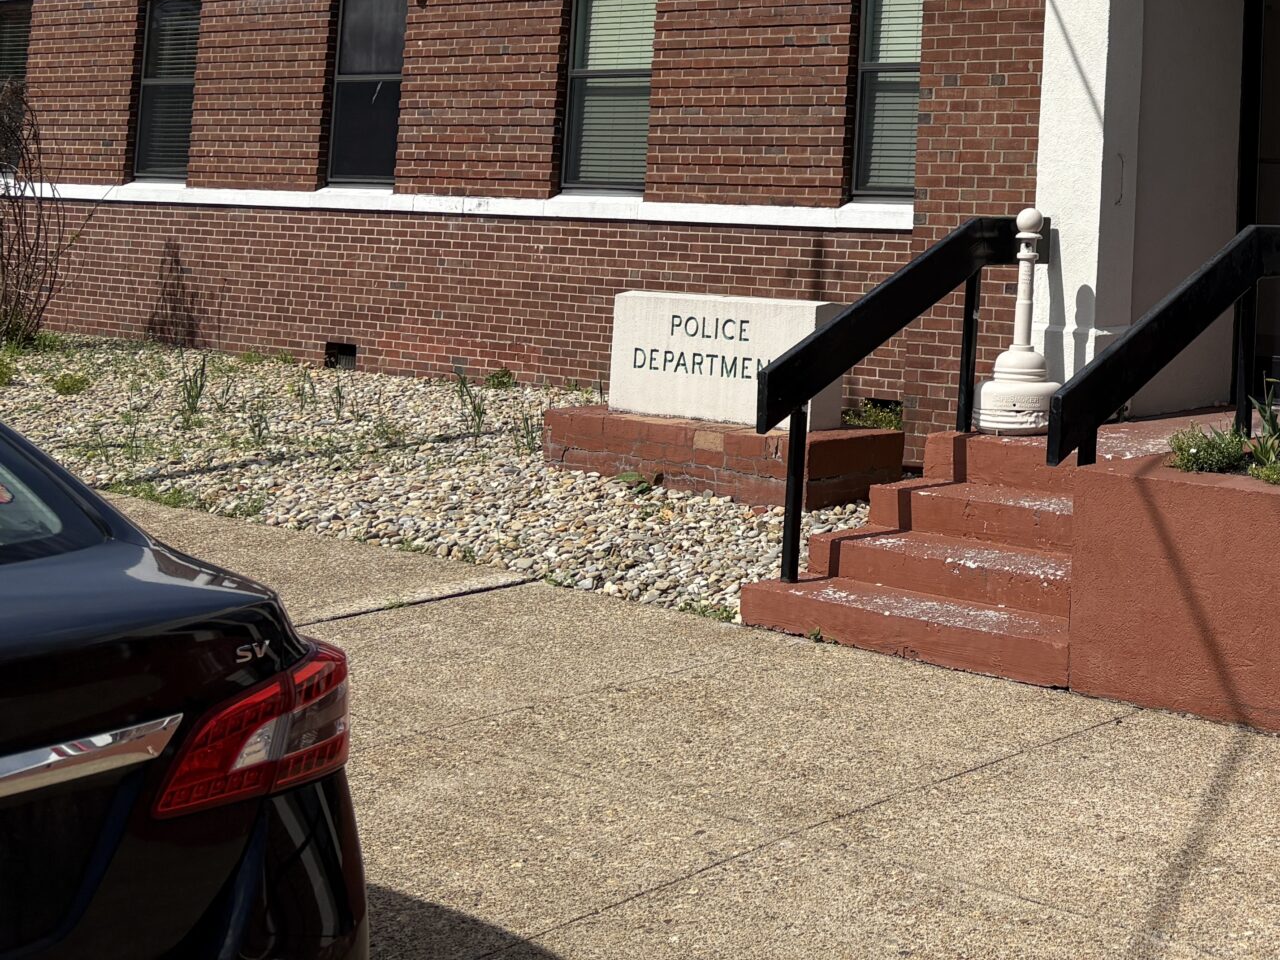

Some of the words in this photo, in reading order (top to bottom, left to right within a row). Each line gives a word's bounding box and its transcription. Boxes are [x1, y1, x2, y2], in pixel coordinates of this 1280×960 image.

[670, 314, 750, 342] POLICE
[633, 347, 771, 380] DEPARTMEN
[235, 639, 271, 664] SV
